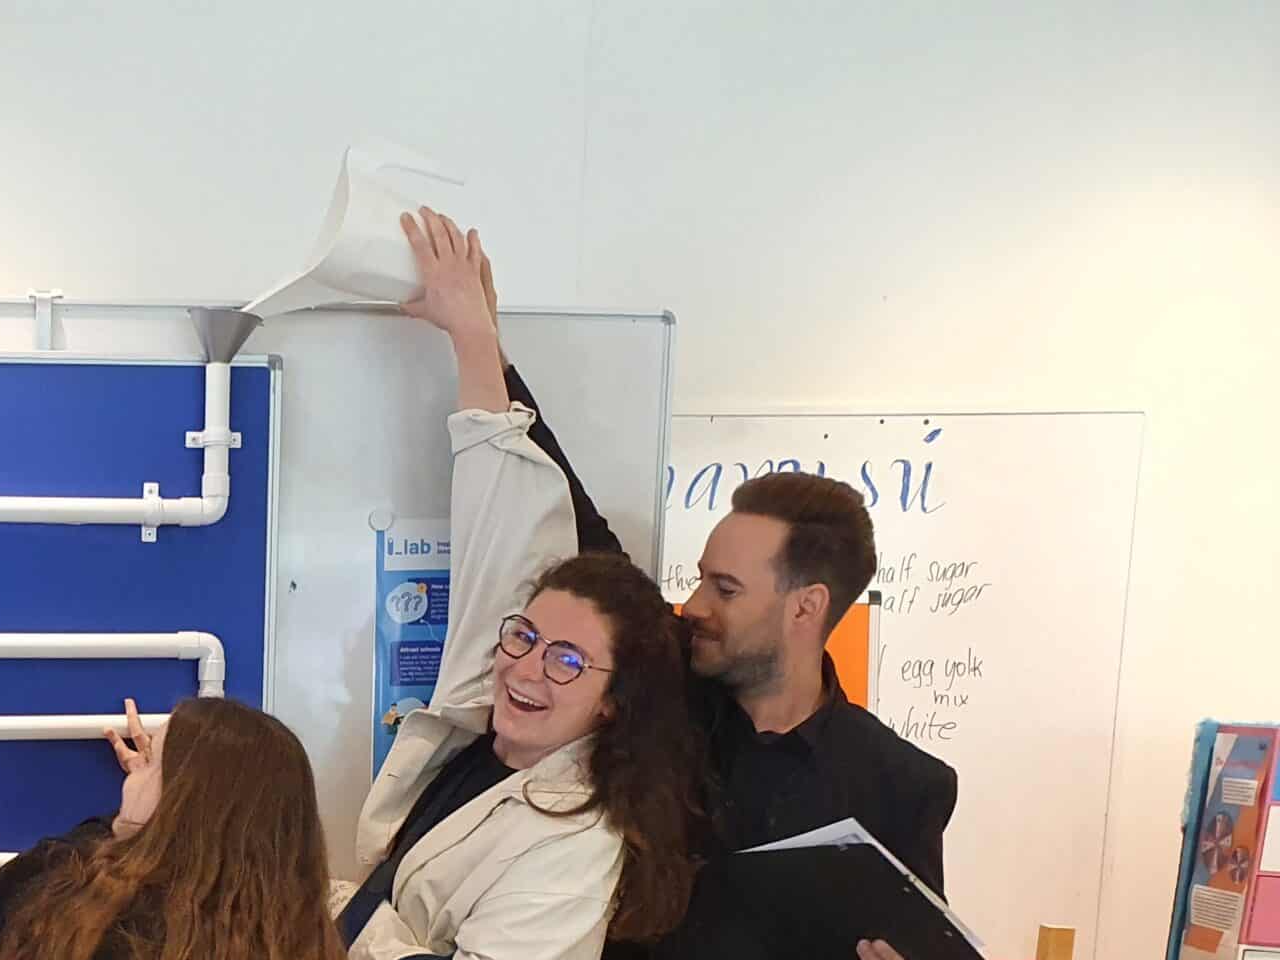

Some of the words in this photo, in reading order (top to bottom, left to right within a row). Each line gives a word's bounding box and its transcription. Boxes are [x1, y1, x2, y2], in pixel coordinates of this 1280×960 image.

[927, 560, 978, 590] sugar
[882, 585, 920, 615] alf
[930, 583, 992, 616] sugar
[901, 659, 935, 688] egg
[944, 647, 983, 691] yolk
[933, 690, 969, 708] mix
